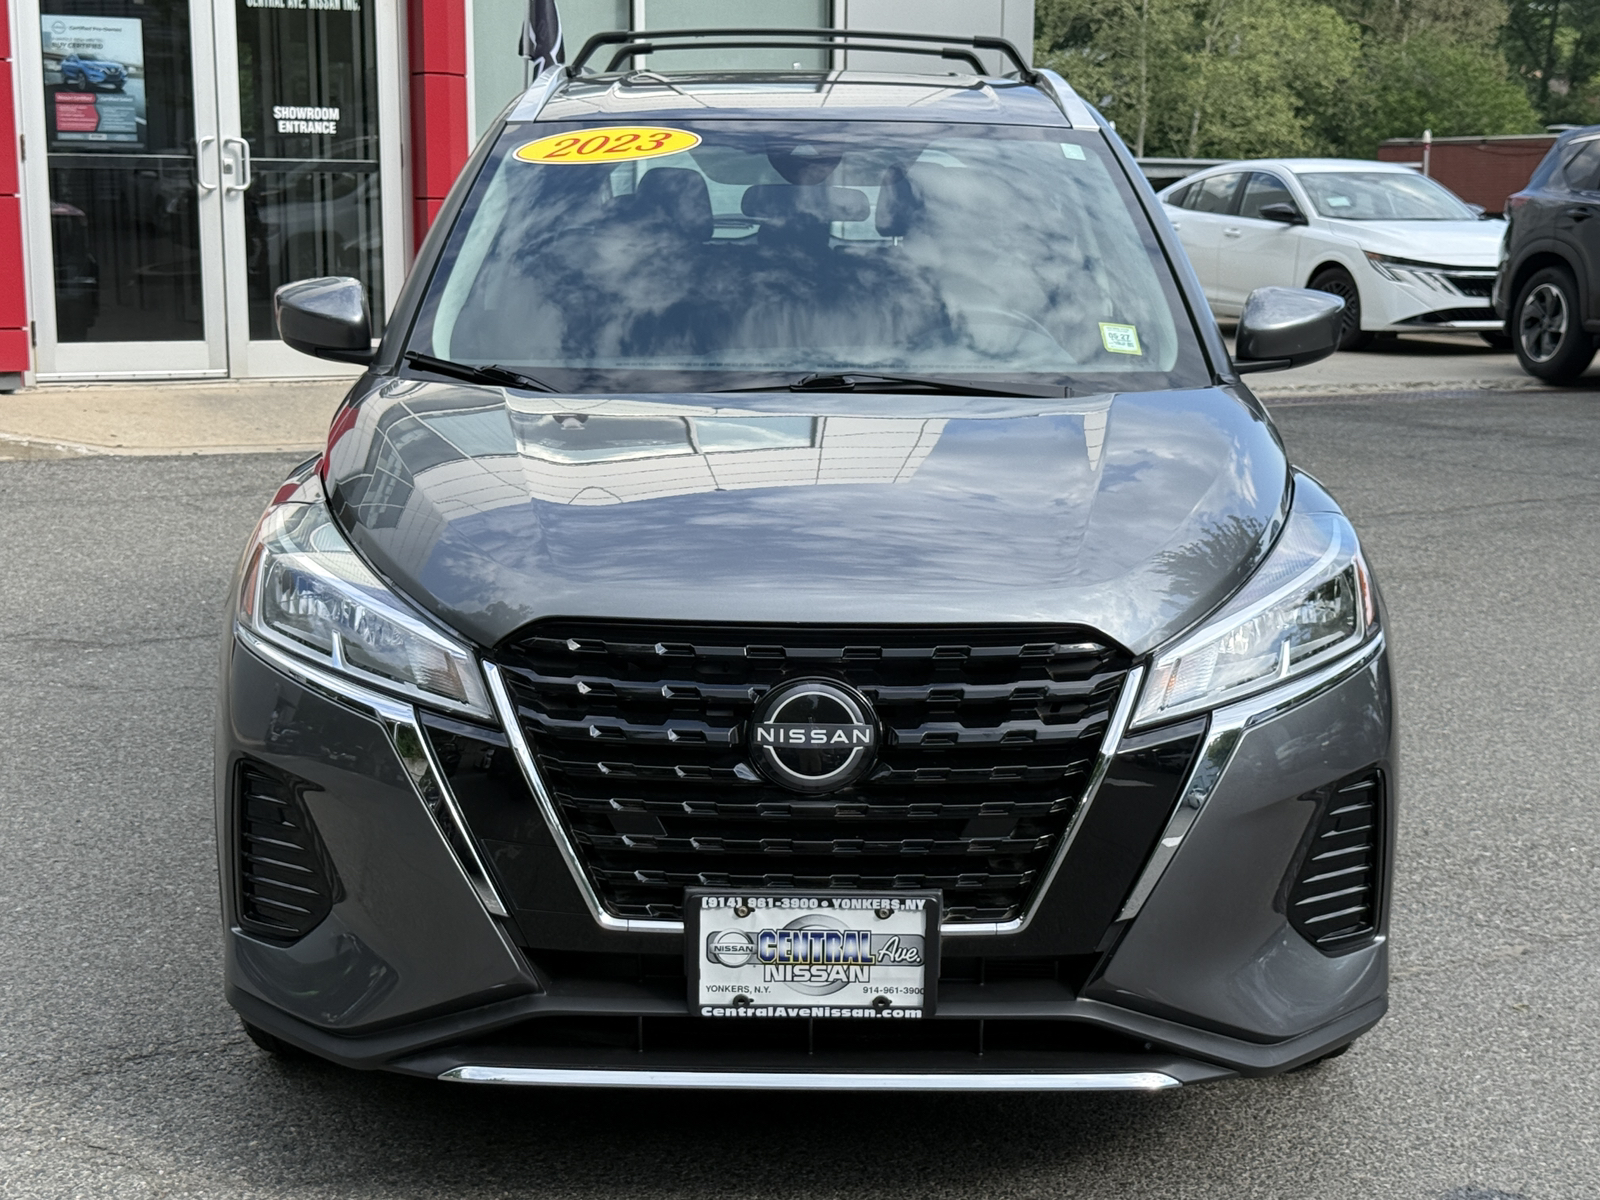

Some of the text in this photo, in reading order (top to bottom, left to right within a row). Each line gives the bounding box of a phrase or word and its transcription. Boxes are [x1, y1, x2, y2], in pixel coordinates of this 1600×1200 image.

[273, 106, 340, 120] SHOWROOM
[278, 120, 337, 134] ENTRANCE
[543, 132, 673, 159] 2023
[757, 727, 870, 744] NISSAN
[747, 898, 818, 909] 961-3900
[757, 929, 922, 965] CENTRAL Ave.
[764, 964, 870, 983] NISSAN
[706, 985, 771, 995] YONKERS, N.Y.
[701, 1006, 923, 1018] CentralAveNissan.com
